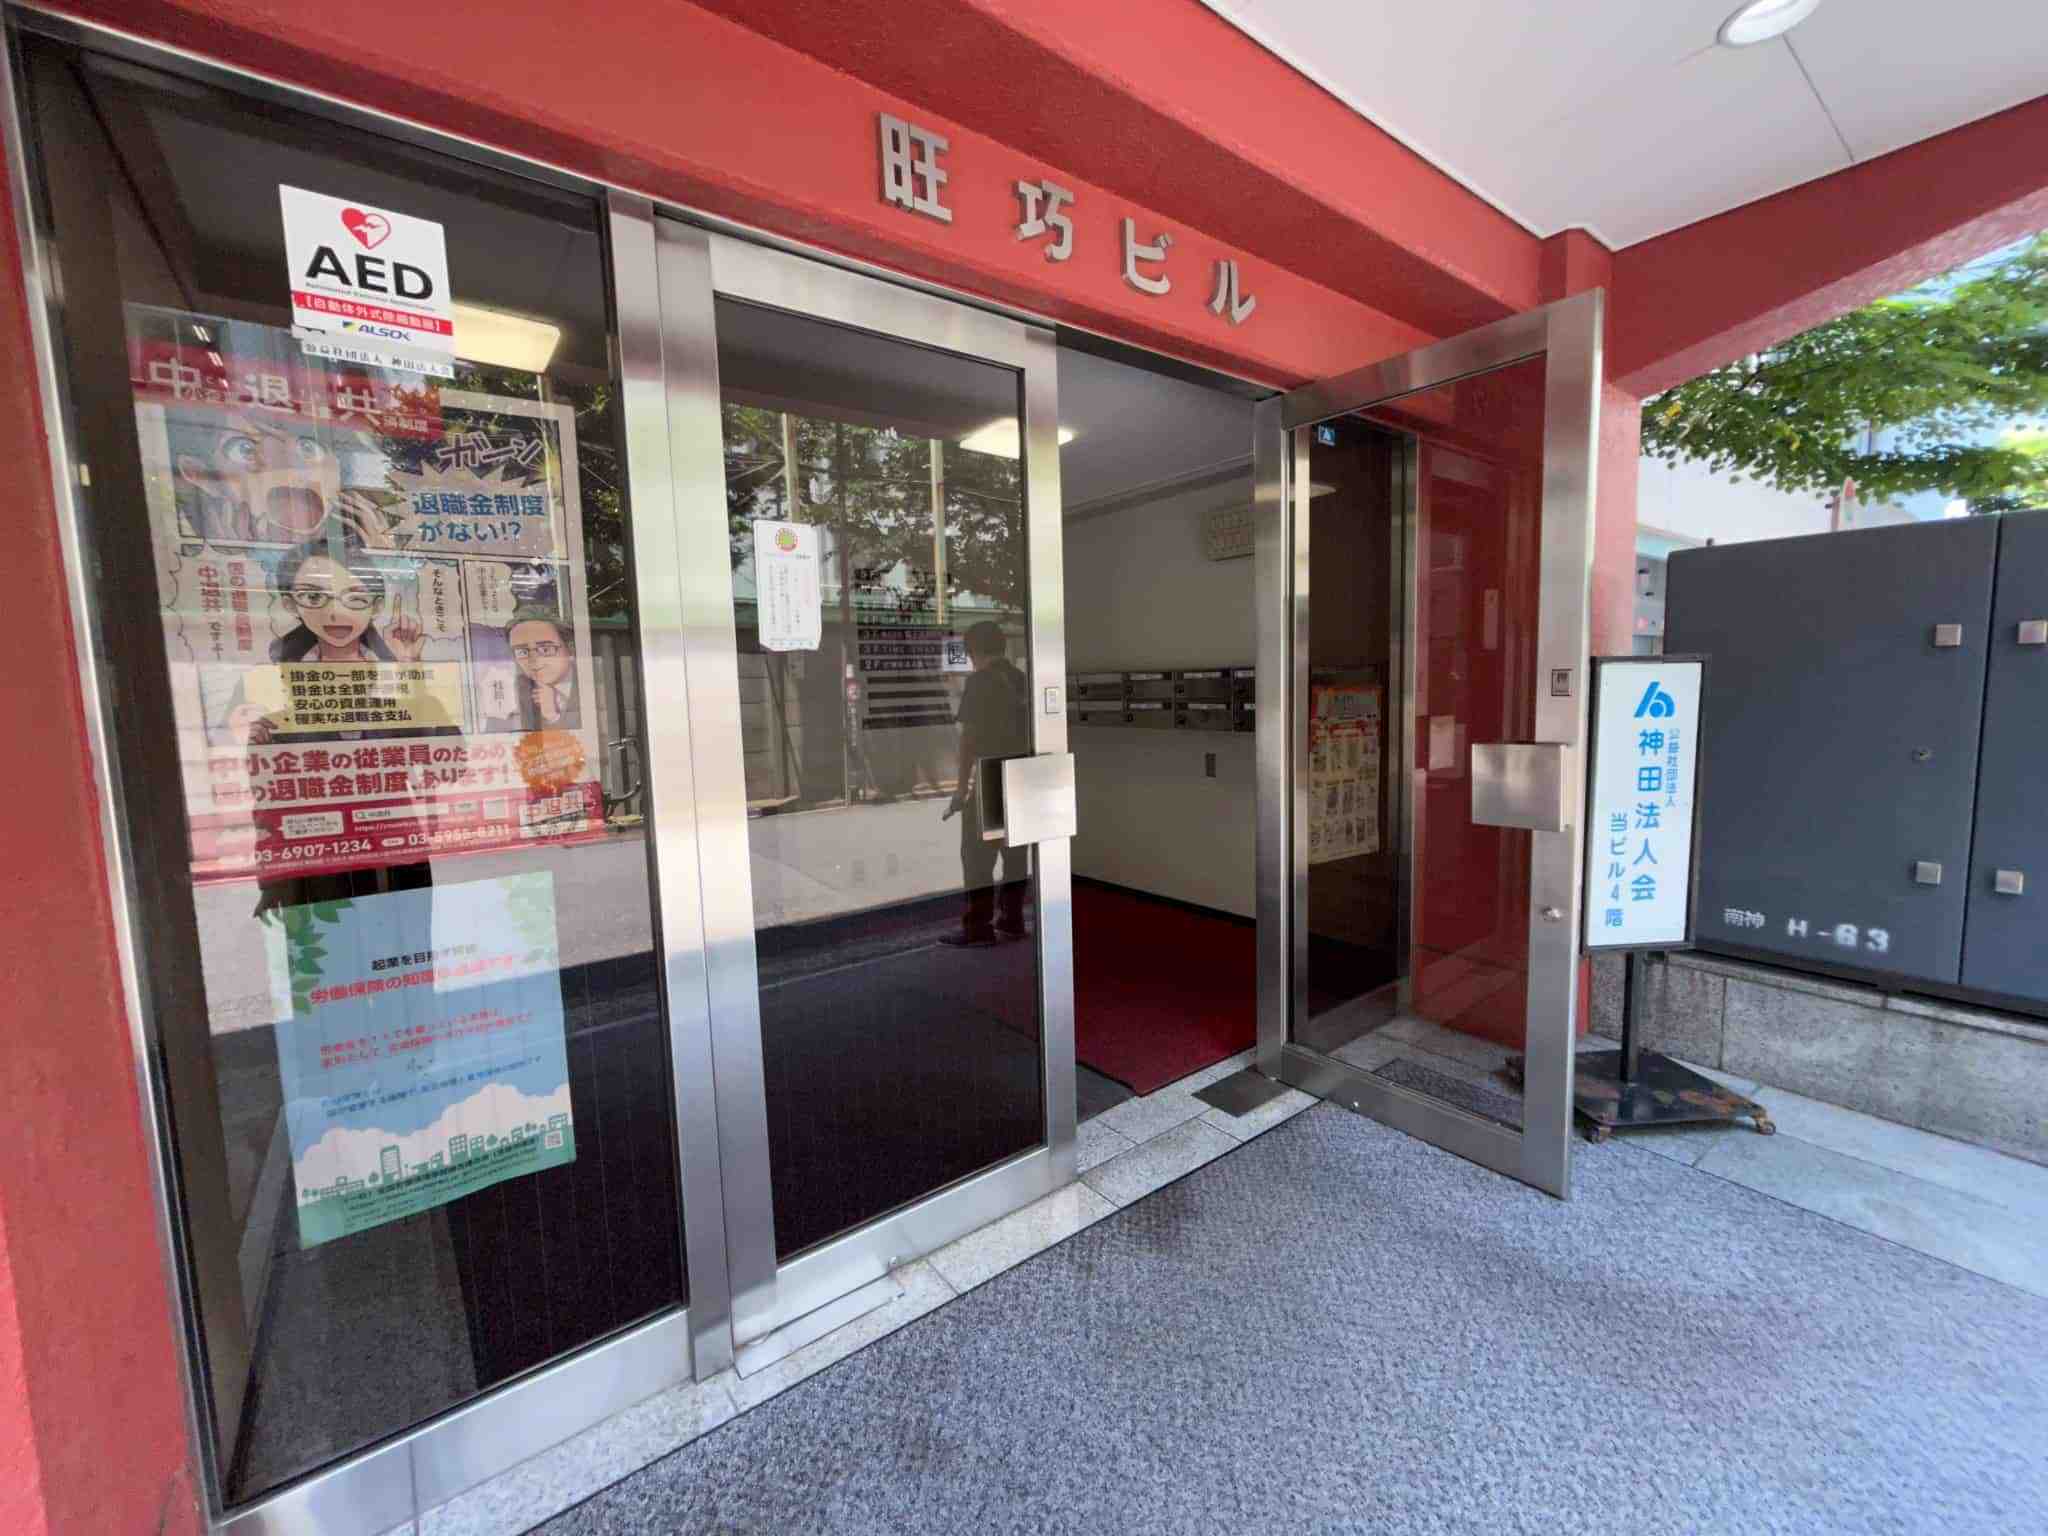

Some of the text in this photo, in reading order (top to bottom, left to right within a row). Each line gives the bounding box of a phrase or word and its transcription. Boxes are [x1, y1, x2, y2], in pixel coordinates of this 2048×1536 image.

[876, 111, 1257, 326] 旺巧ビル
[305, 246, 434, 300] AED
[358, 323, 413, 342] ALSOK
[436, 431, 544, 474] ガーン
[412, 492, 546, 518] 退職金制度
[1631, 727, 1666, 902] 神田法人会
[1604, 811, 1629, 927] 当ビル4階
